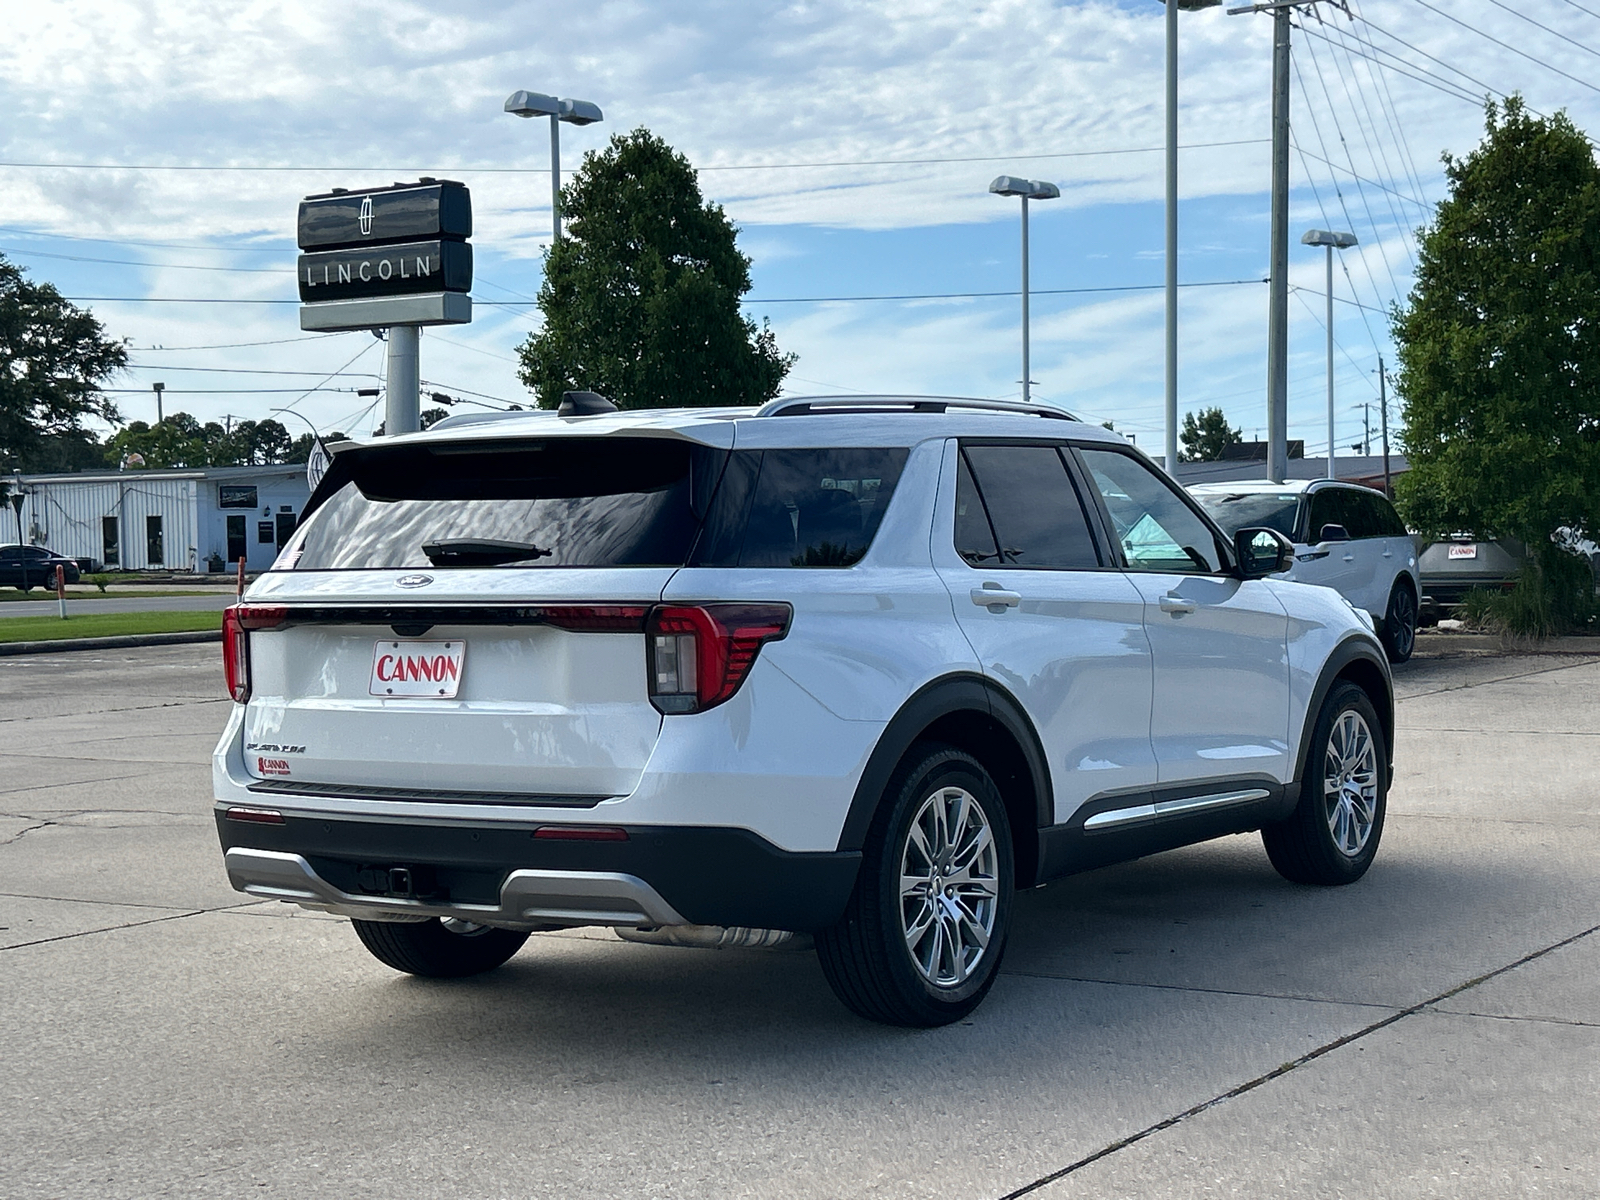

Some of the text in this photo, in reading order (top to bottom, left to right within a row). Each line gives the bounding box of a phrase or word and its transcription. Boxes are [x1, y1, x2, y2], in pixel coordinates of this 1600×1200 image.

[307, 256, 430, 287] LINCOLN
[376, 654, 460, 682] CANNON
[264, 759, 290, 769] CANNON
